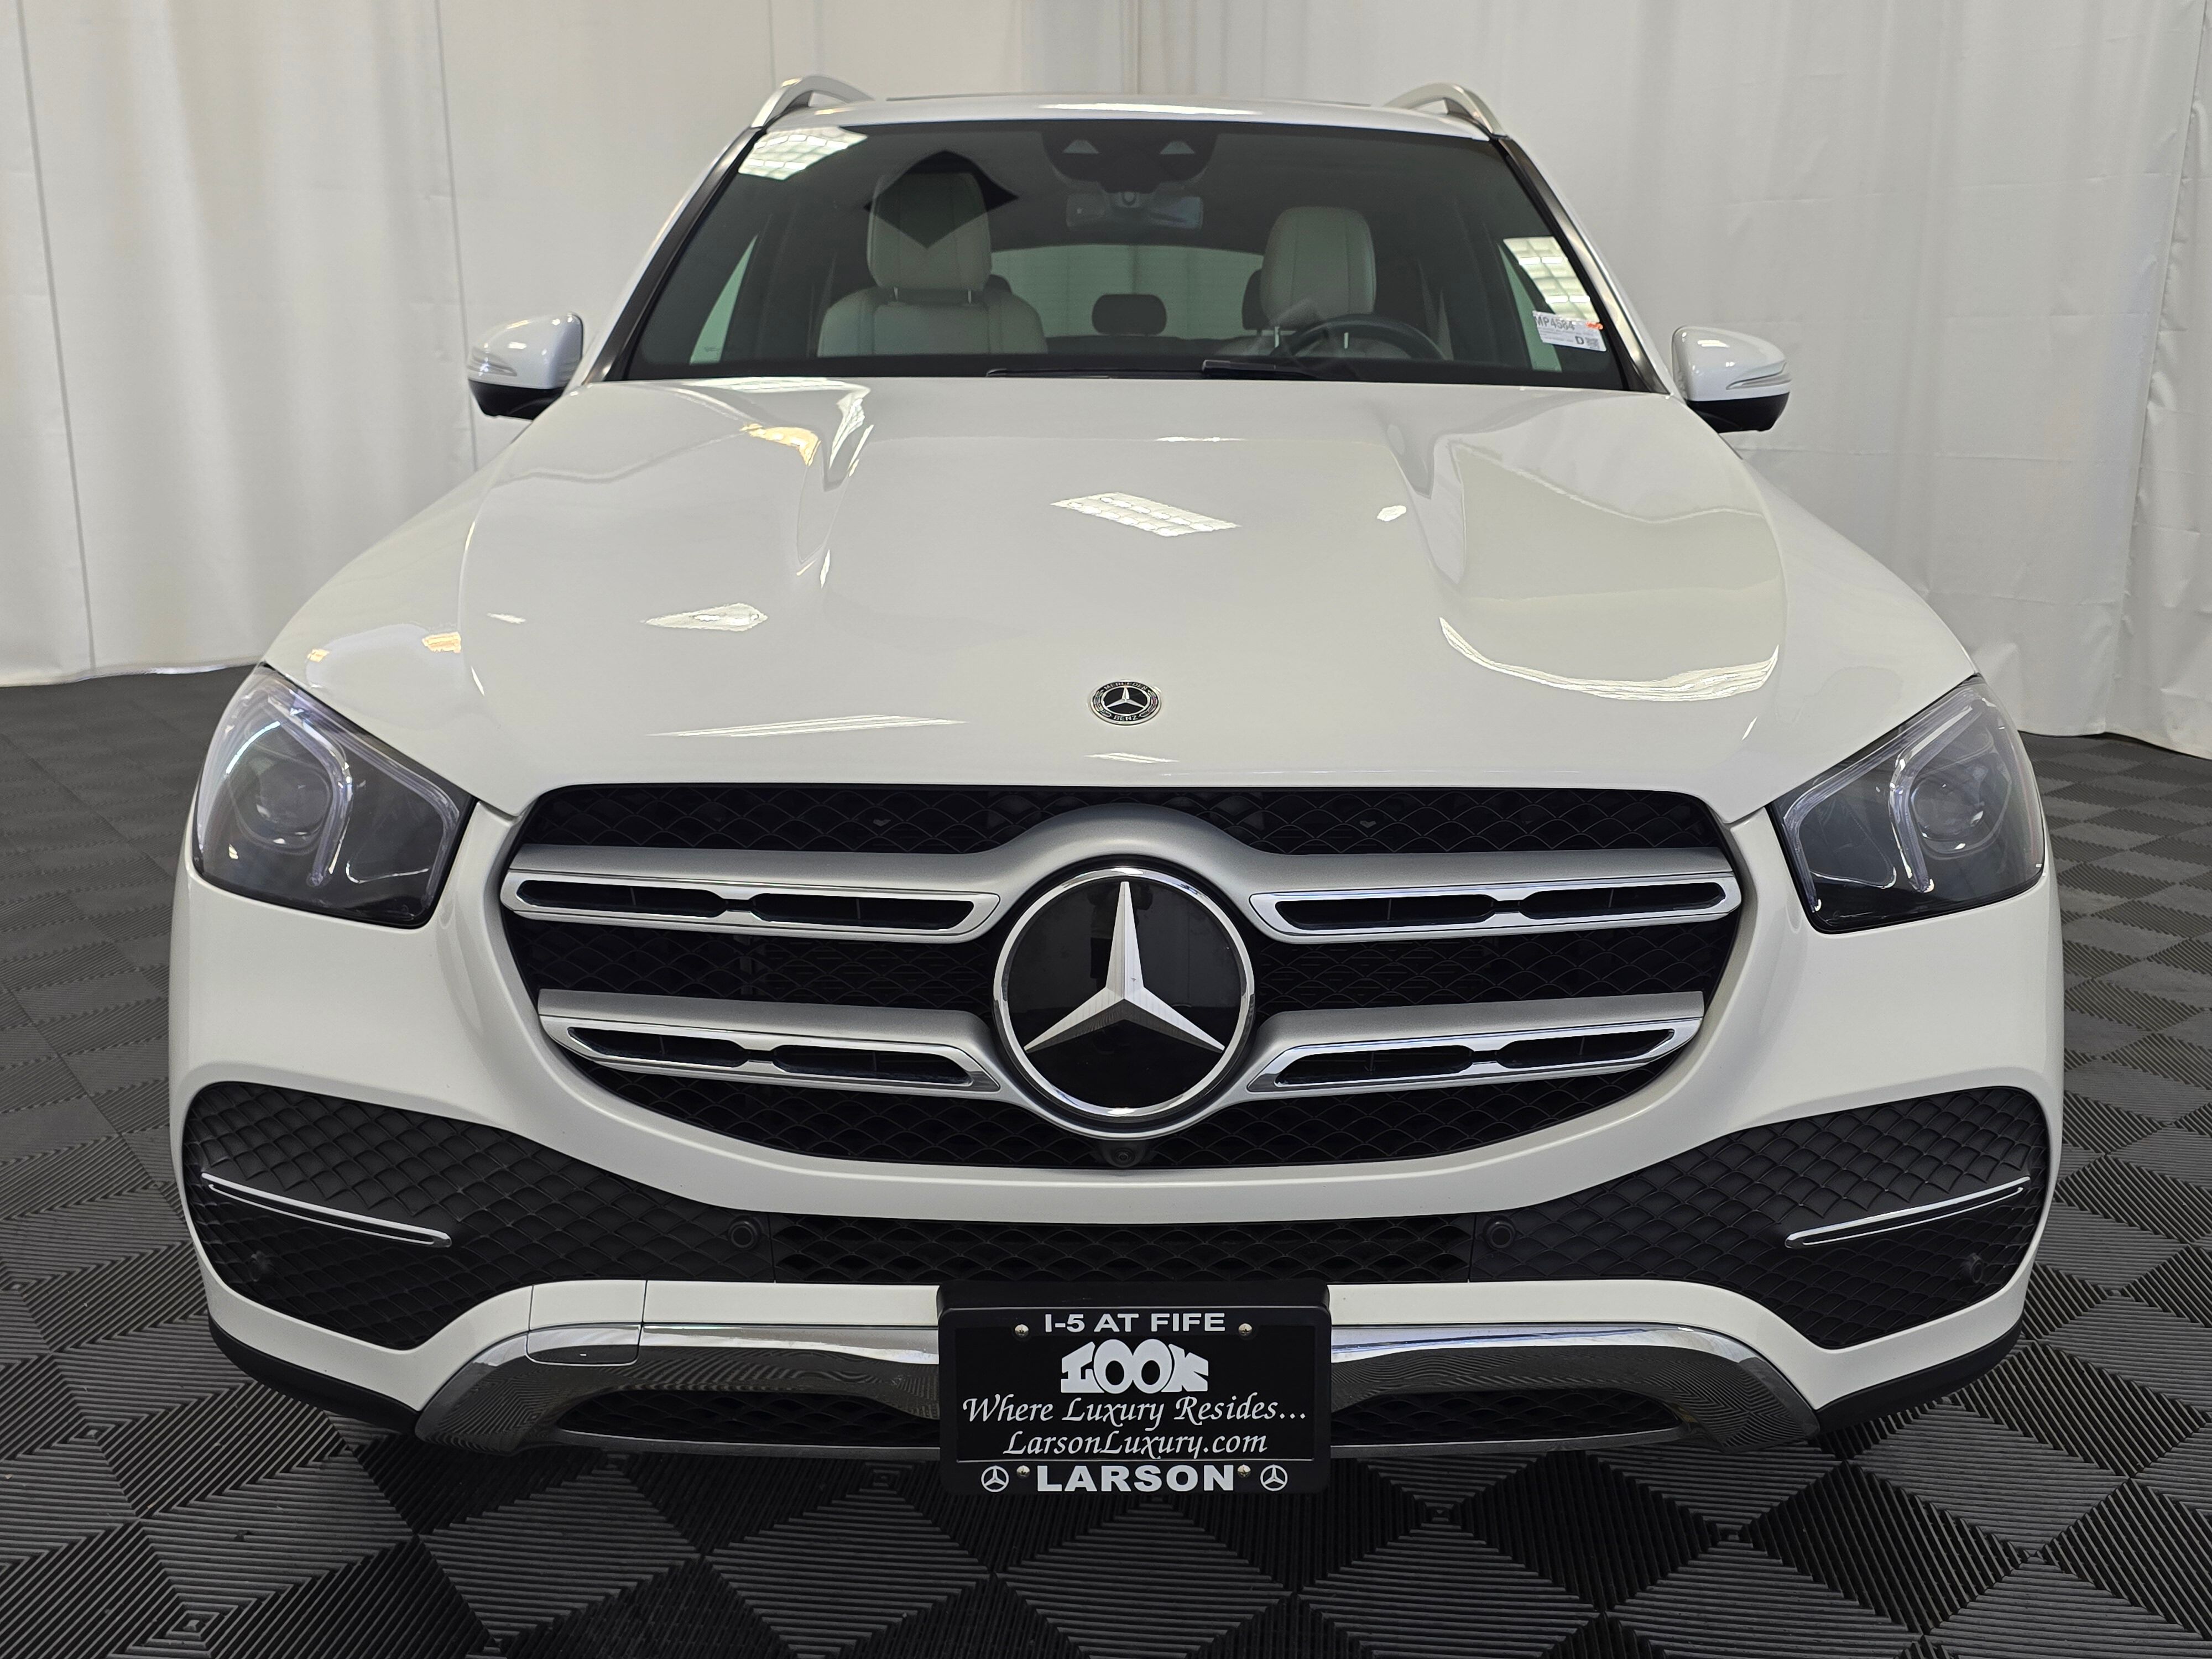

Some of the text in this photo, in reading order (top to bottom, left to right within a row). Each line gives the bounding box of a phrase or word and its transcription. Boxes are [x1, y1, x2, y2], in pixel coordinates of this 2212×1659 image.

[1045, 1313, 1225, 1332] I-5 AT FIFE
[962, 1392, 1306, 1431] Where Luxury Resides...
[1003, 1430, 1268, 1459] LarsonLuxury.com
[1037, 1464, 1234, 1492] LARSON
